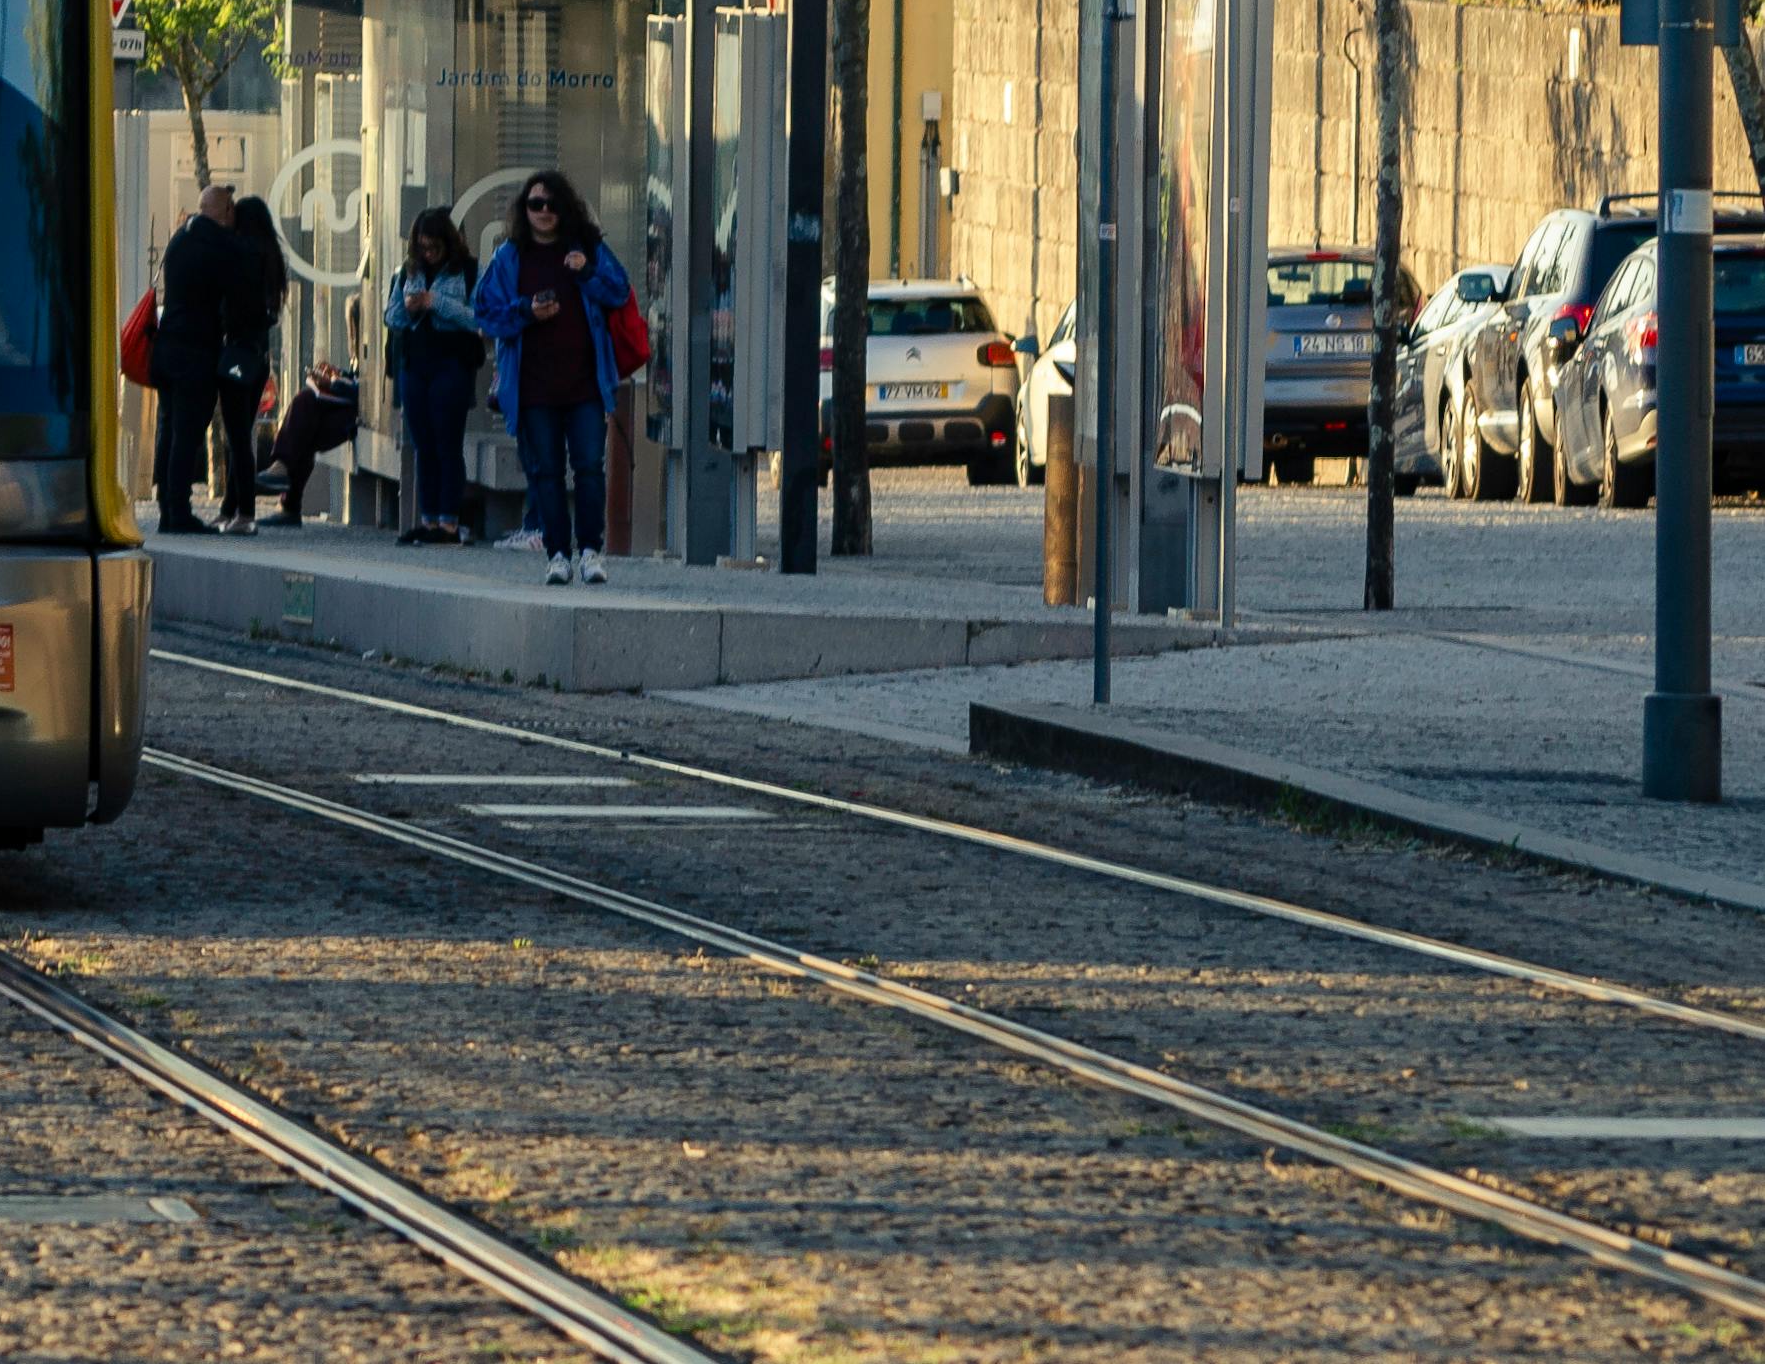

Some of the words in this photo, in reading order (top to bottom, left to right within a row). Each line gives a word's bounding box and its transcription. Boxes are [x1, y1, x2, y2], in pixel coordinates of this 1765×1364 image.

[436, 67, 510, 87] Jardim
[517, 68, 542, 87] do
[549, 68, 614, 88] Morro
